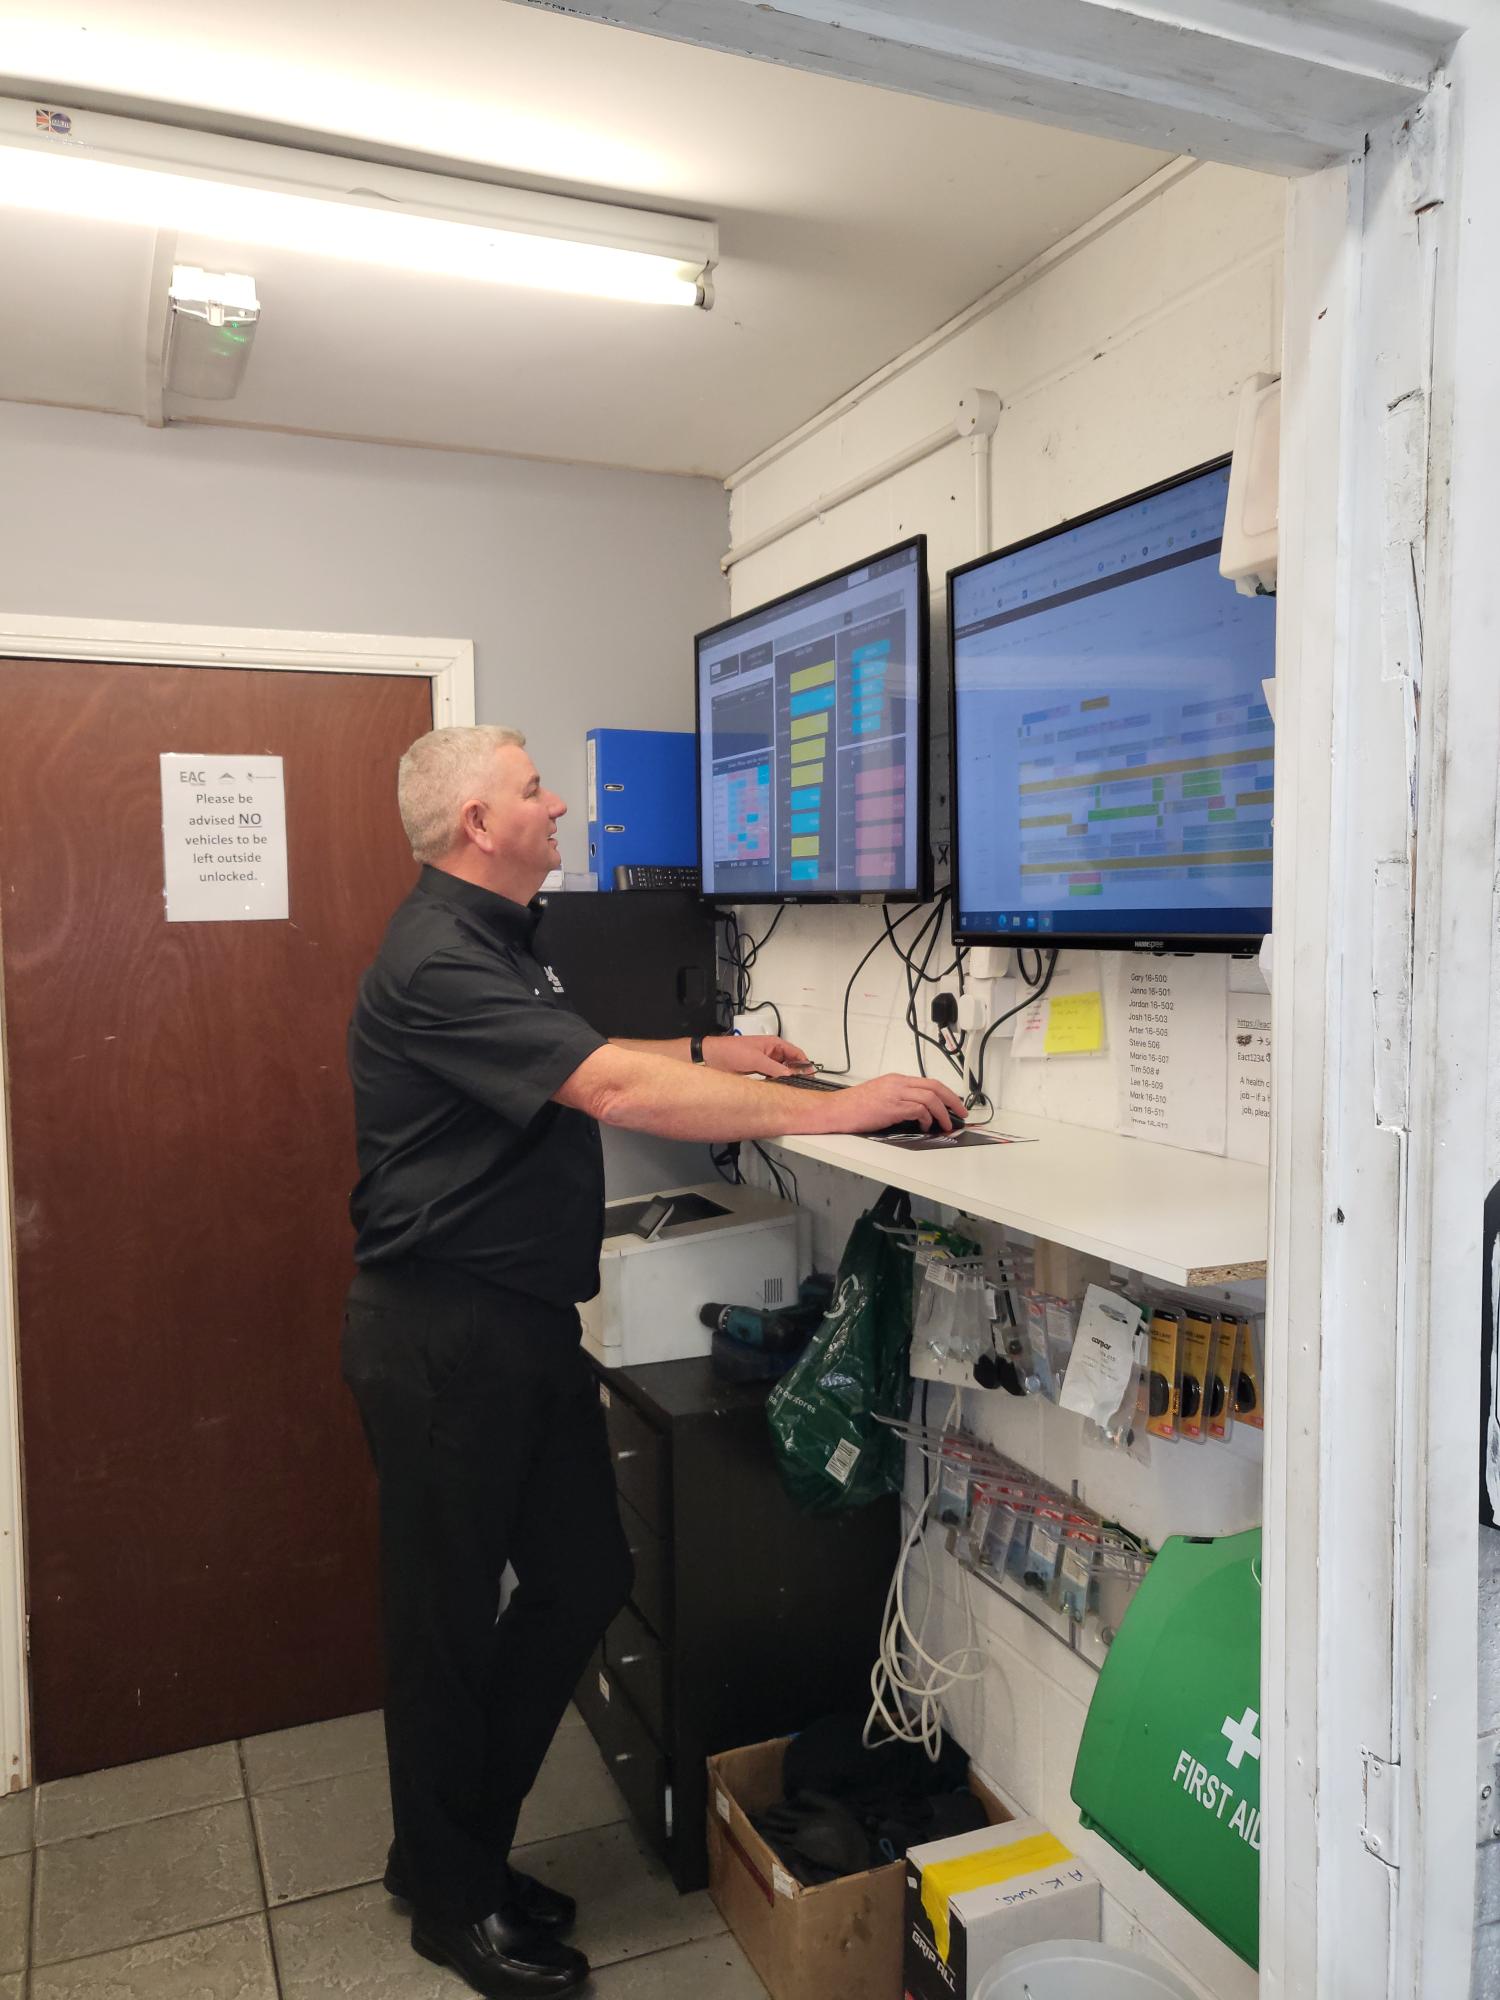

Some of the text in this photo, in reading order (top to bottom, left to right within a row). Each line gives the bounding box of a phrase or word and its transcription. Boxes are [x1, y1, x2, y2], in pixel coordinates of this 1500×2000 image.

[196, 793, 253, 804] Please be
[189, 813, 262, 826] advised NO
[185, 834, 268, 846] vehicles to be
[193, 852, 262, 863] left outside
[199, 871, 258, 882] unlocked.
[1172, 1749, 1234, 1819] FIRST
[912, 1930, 956, 1992] GRIP ALL
